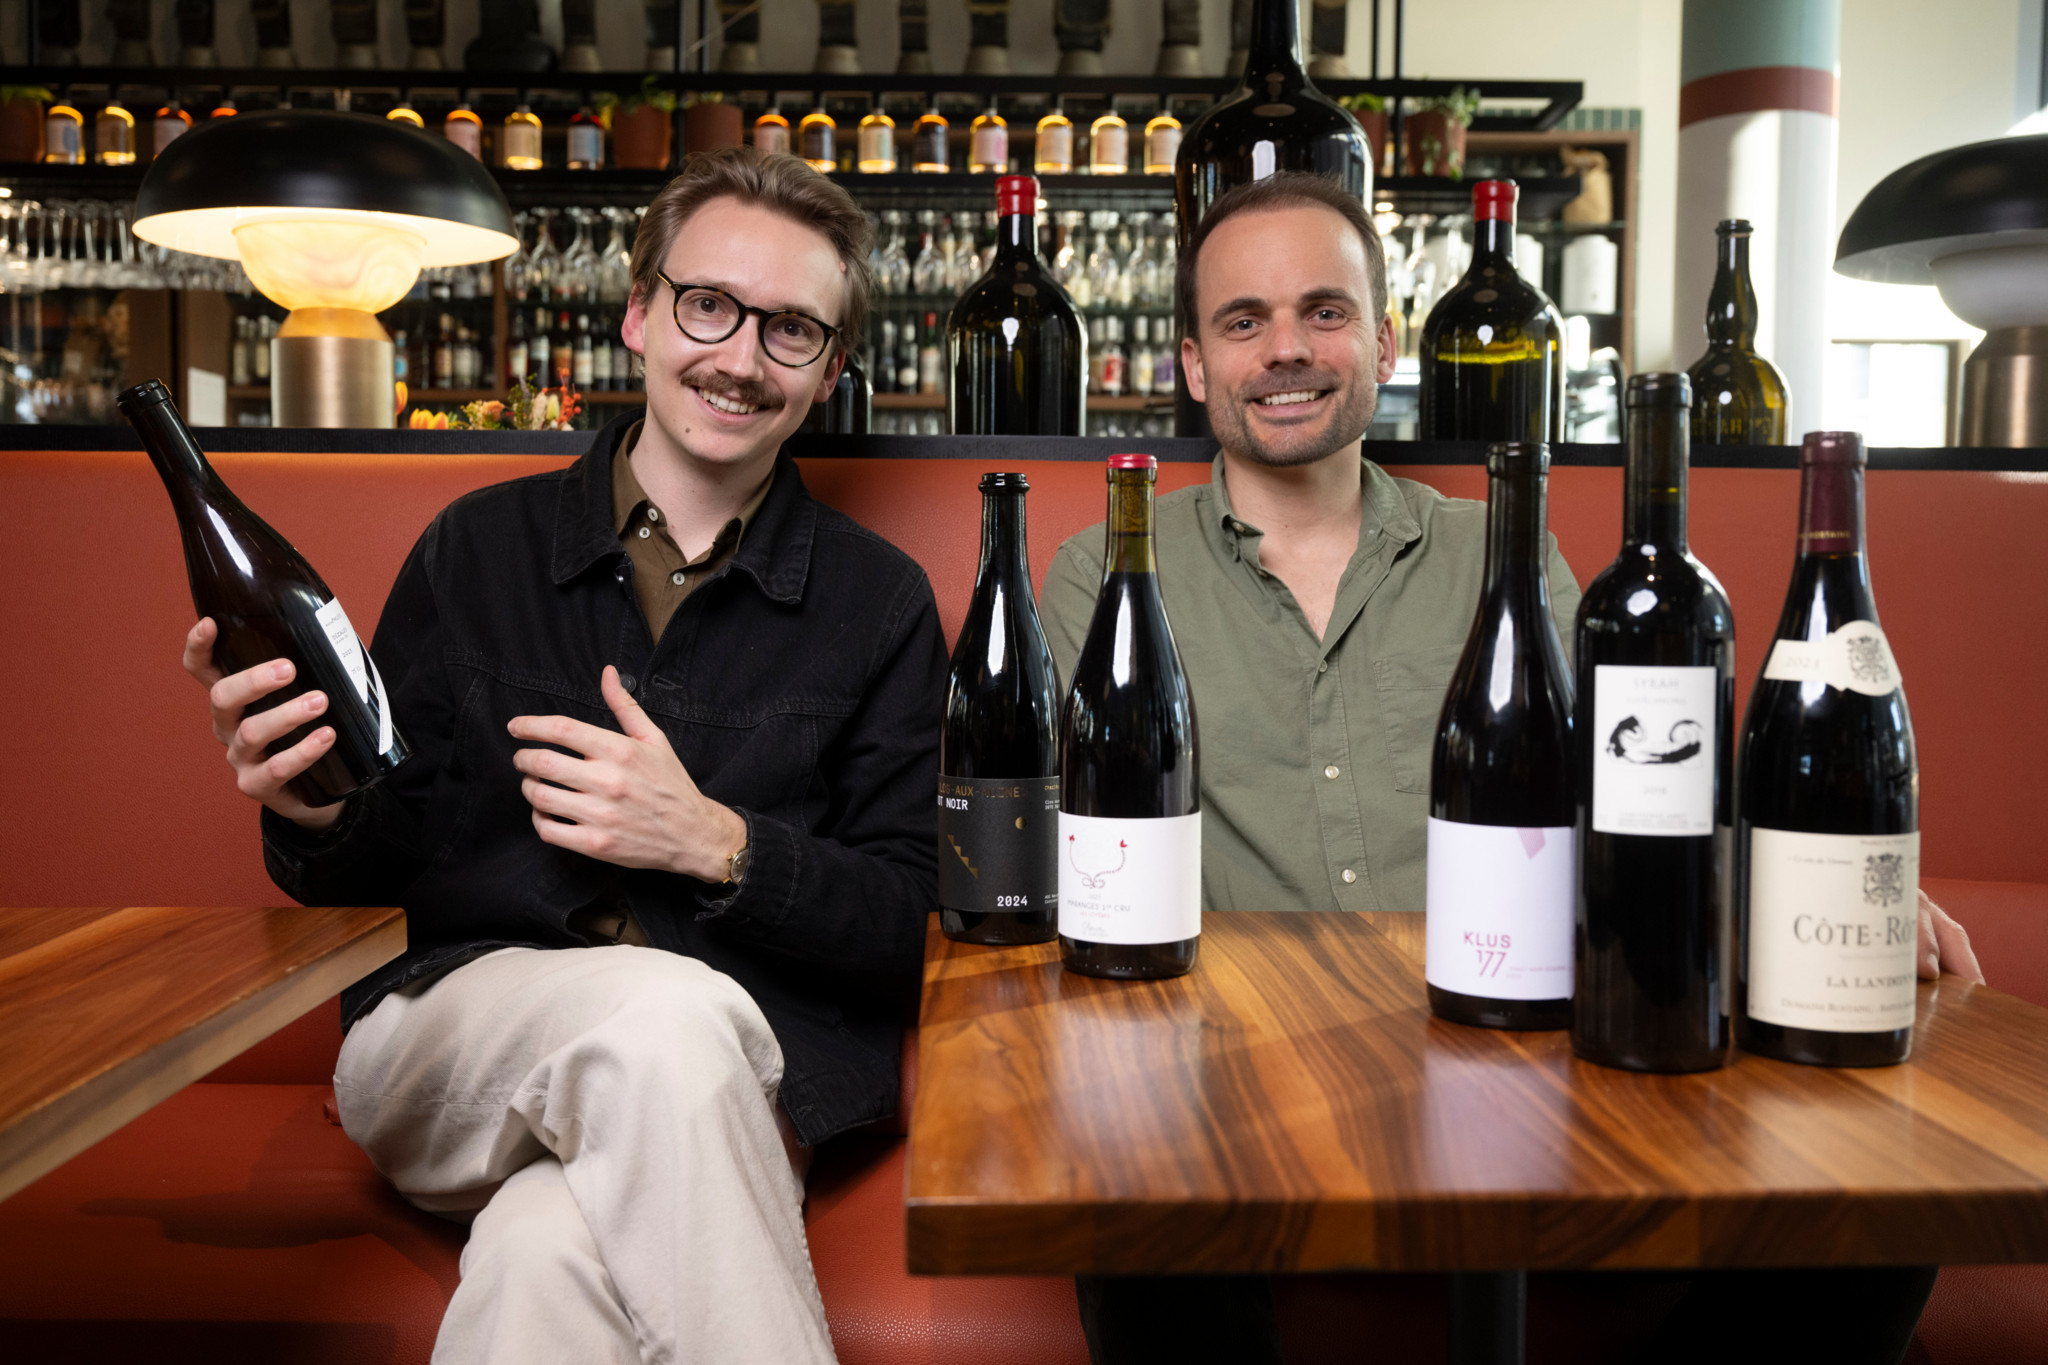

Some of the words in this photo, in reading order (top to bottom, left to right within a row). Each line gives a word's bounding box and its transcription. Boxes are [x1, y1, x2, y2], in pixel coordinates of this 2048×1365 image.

[946, 797, 968, 810] NOIR
[997, 896, 1028, 906] 2024
[1114, 904, 1131, 912] CRU
[1464, 931, 1511, 949] KLUS
[1476, 949, 1506, 977] 177
[1826, 976, 1848, 988] LA
